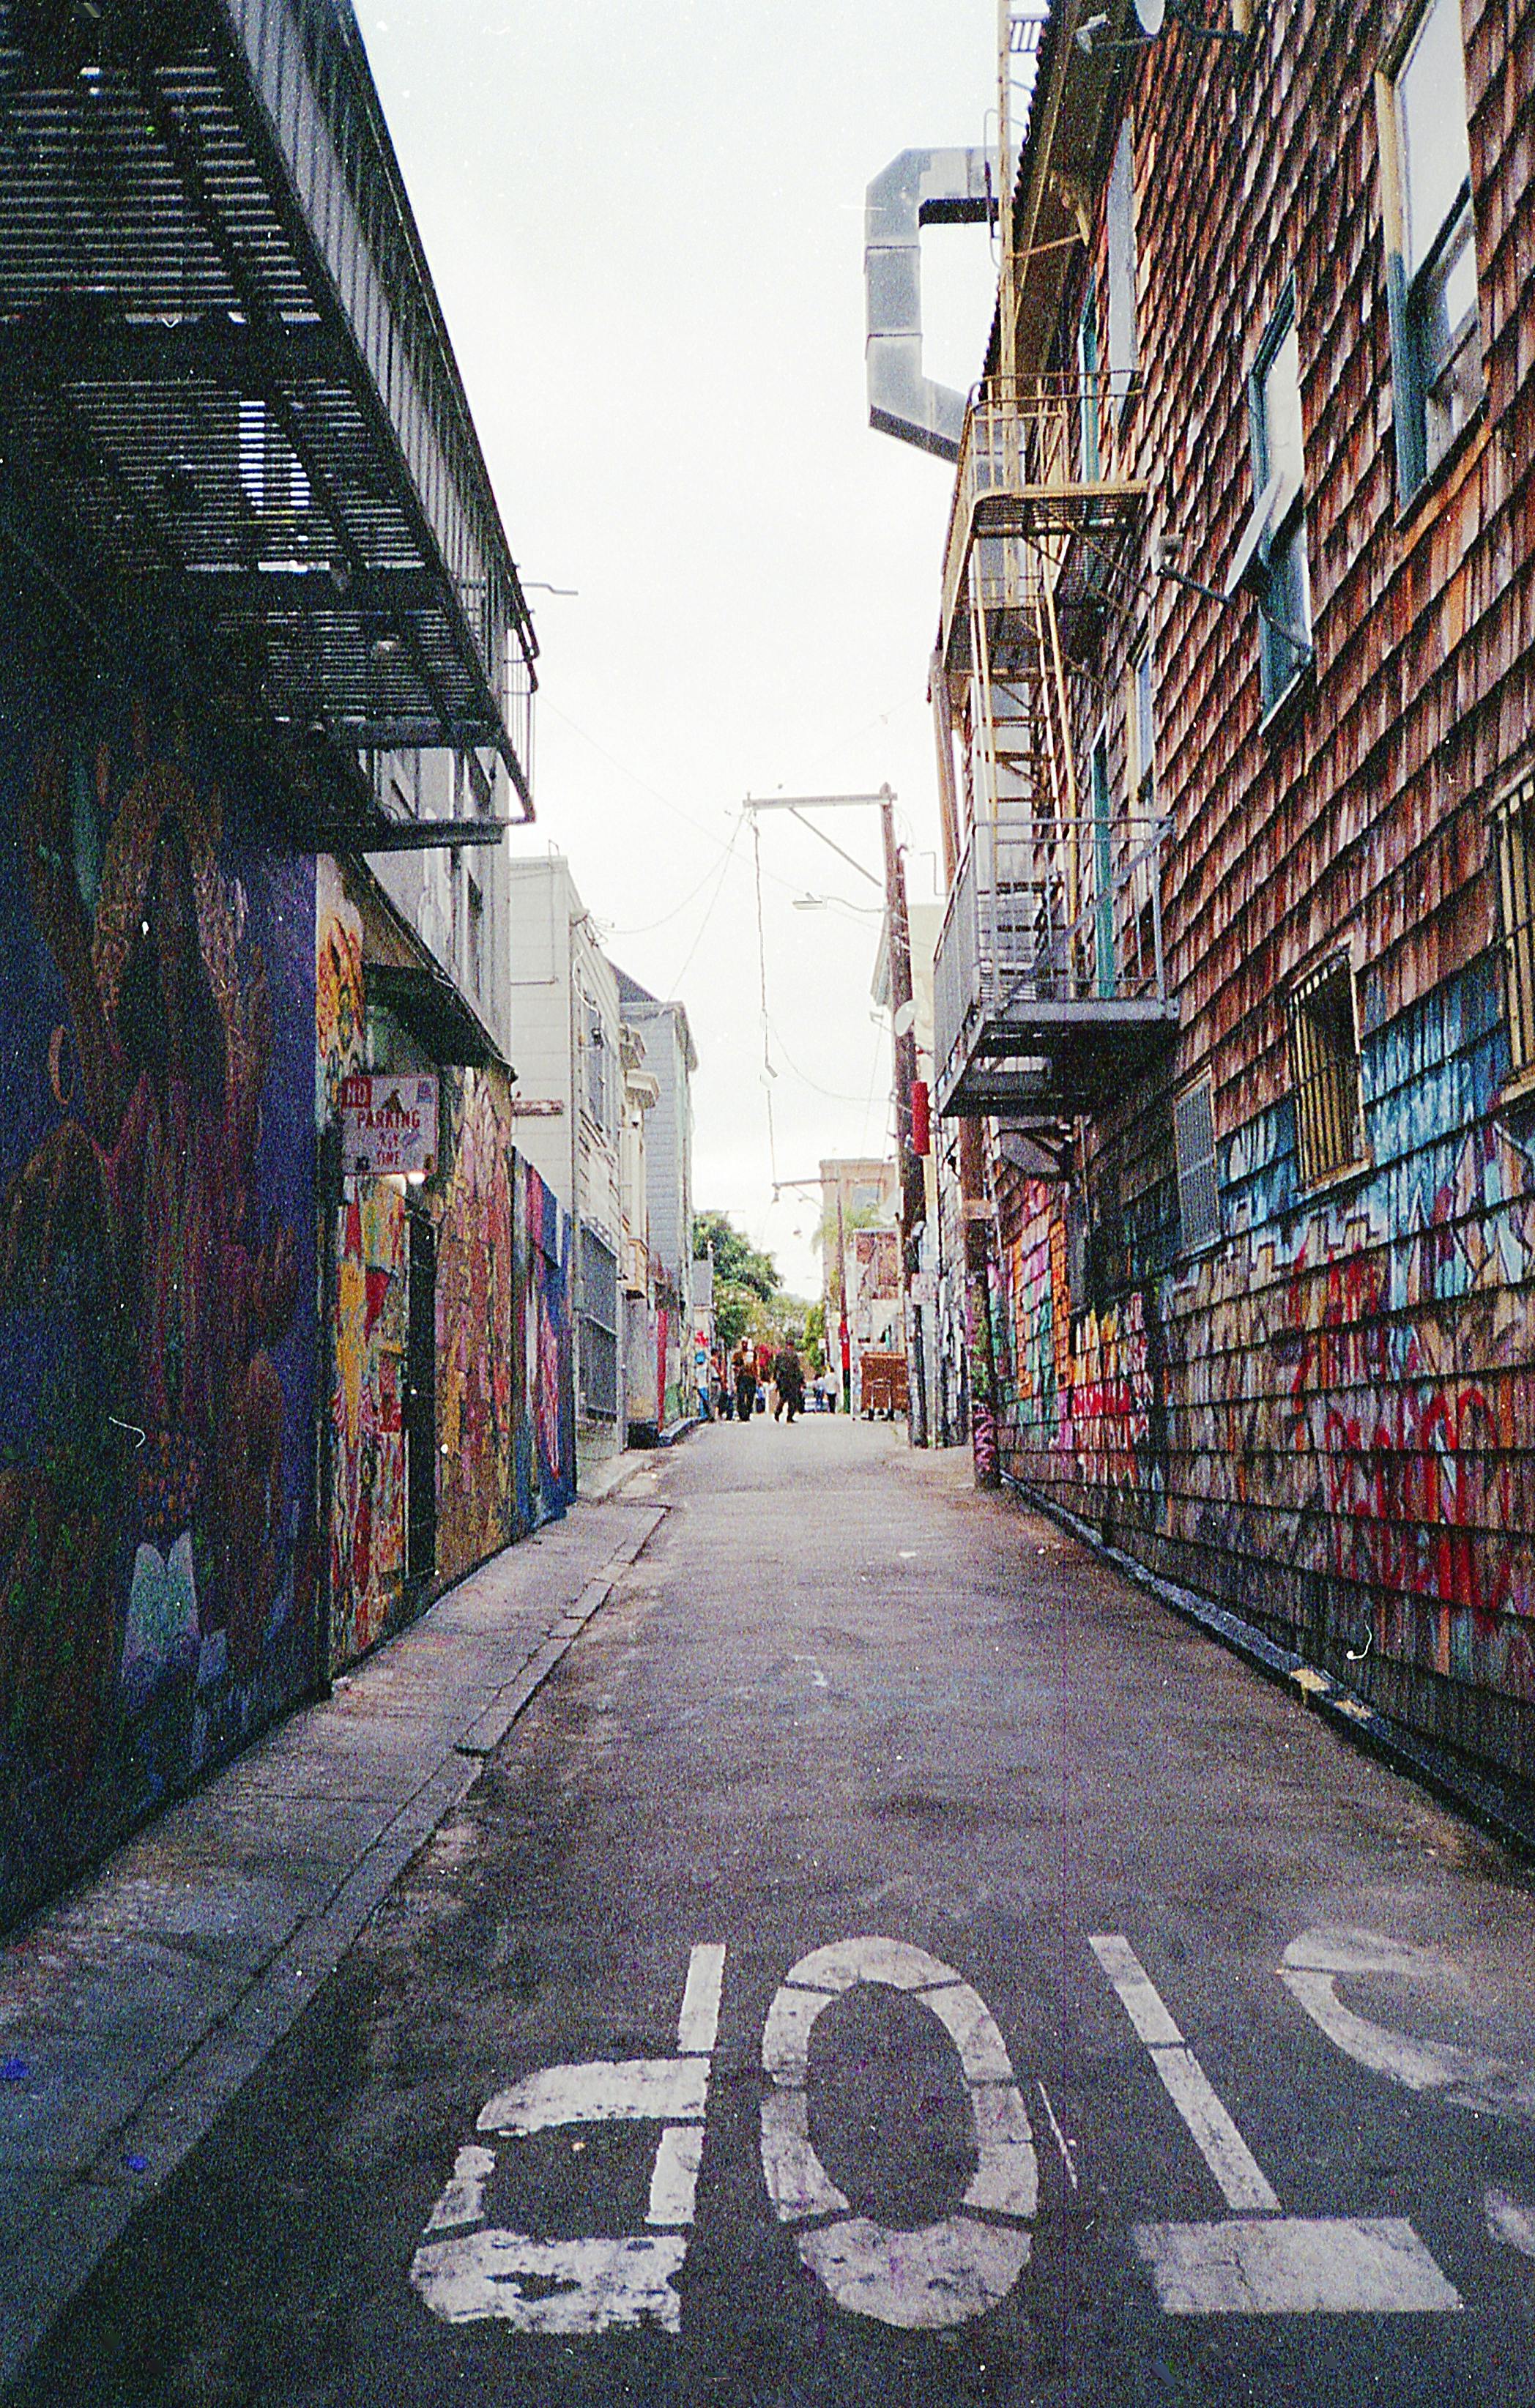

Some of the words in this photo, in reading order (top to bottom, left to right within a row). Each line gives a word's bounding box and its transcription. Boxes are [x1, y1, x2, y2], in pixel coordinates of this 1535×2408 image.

[346, 1080, 368, 1104] NO
[357, 1109, 421, 1129] PARKING
[376, 1151, 401, 1165] TIME
